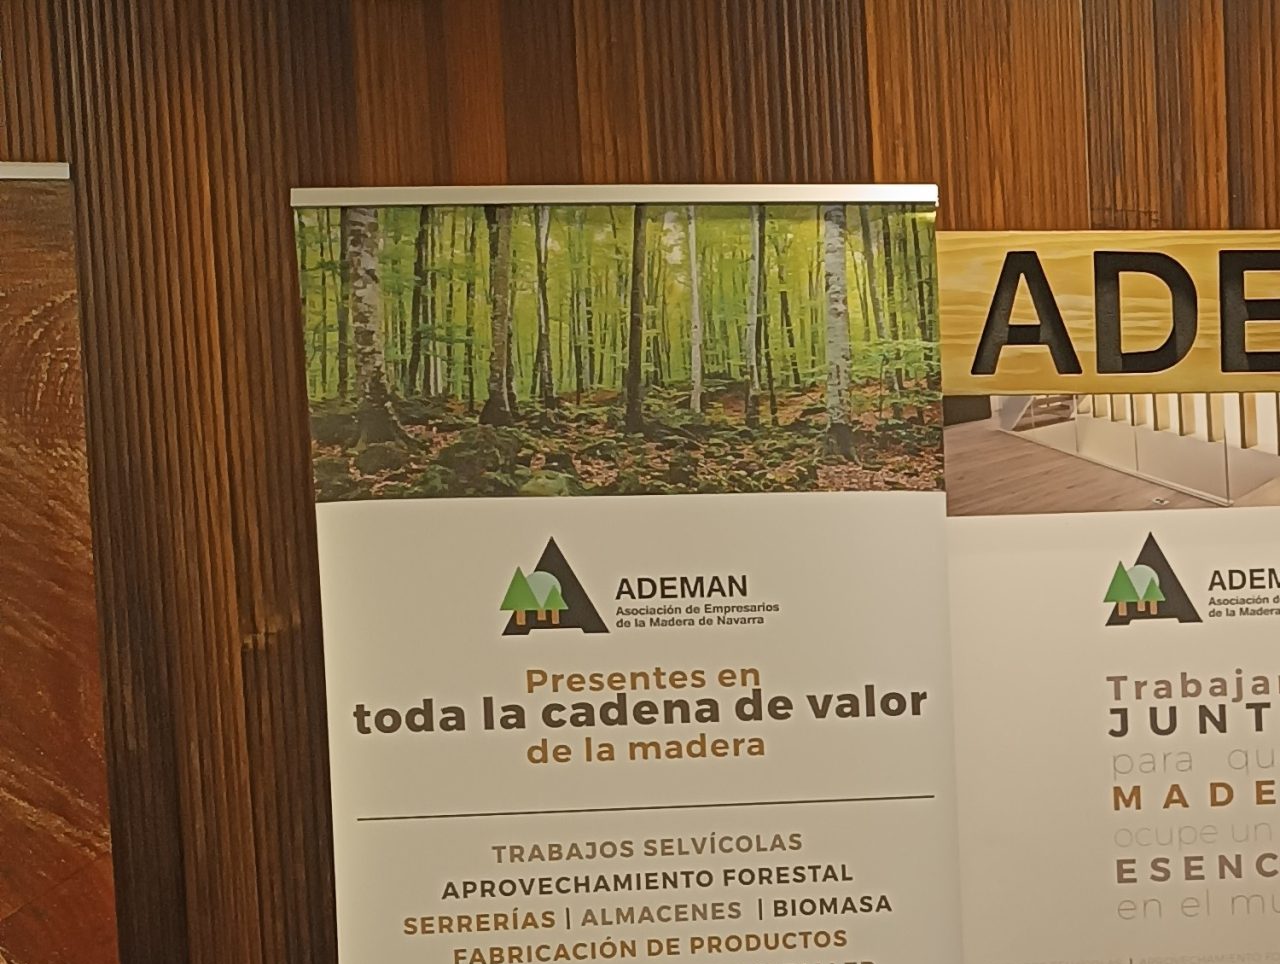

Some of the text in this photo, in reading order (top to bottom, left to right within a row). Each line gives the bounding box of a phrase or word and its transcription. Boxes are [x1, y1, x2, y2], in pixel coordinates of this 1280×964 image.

[616, 575, 747, 600] ADEMAN
[1208, 595, 1269, 606] Asociación
[616, 602, 779, 615] Asociación de Empresarios
[616, 616, 764, 627] de la Madera de Navarra
[1209, 609, 1222, 617] de
[1226, 608, 1235, 616] la
[1239, 607, 1280, 616] Madera
[527, 667, 760, 693] Presentes en
[353, 685, 927, 734] toda la cadena de valor
[527, 733, 764, 763] de la madera
[1113, 751, 1192, 781] para
[492, 832, 802, 863] TRABAJOS SELVÍCOLAS
[1114, 824, 1219, 852] ocupe
[1231, 820, 1274, 847] un
[442, 864, 853, 899] APROVECHAMIENTO FORESTAL
[404, 895, 892, 935] SERRERÍAS ALMACENES BIOMASA
[1118, 899, 1162, 920] en
[1181, 888, 1210, 917] el
[648, 938, 680, 956] DE
[691, 930, 847, 954] PRODUCTOS
